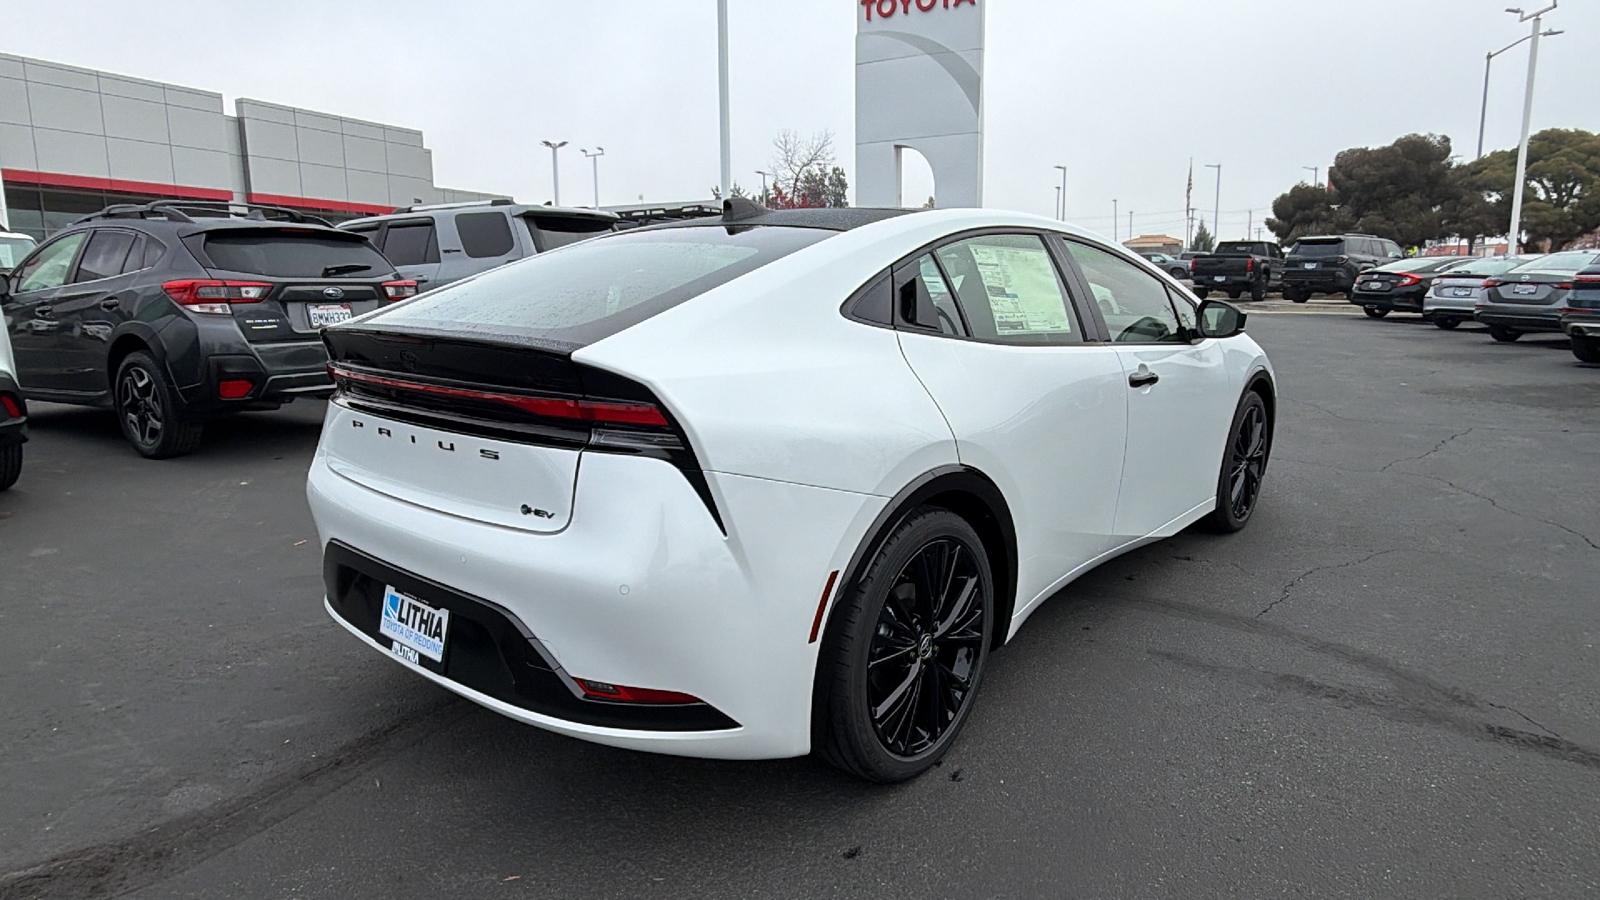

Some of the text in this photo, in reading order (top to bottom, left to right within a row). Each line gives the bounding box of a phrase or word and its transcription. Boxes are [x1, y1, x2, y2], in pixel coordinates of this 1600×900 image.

[352, 420, 500, 460] PRIUS
[383, 618, 443, 655] TOYOTA OF REDDING
[397, 598, 443, 643] LITHIA
[397, 642, 420, 665] LITHIA
